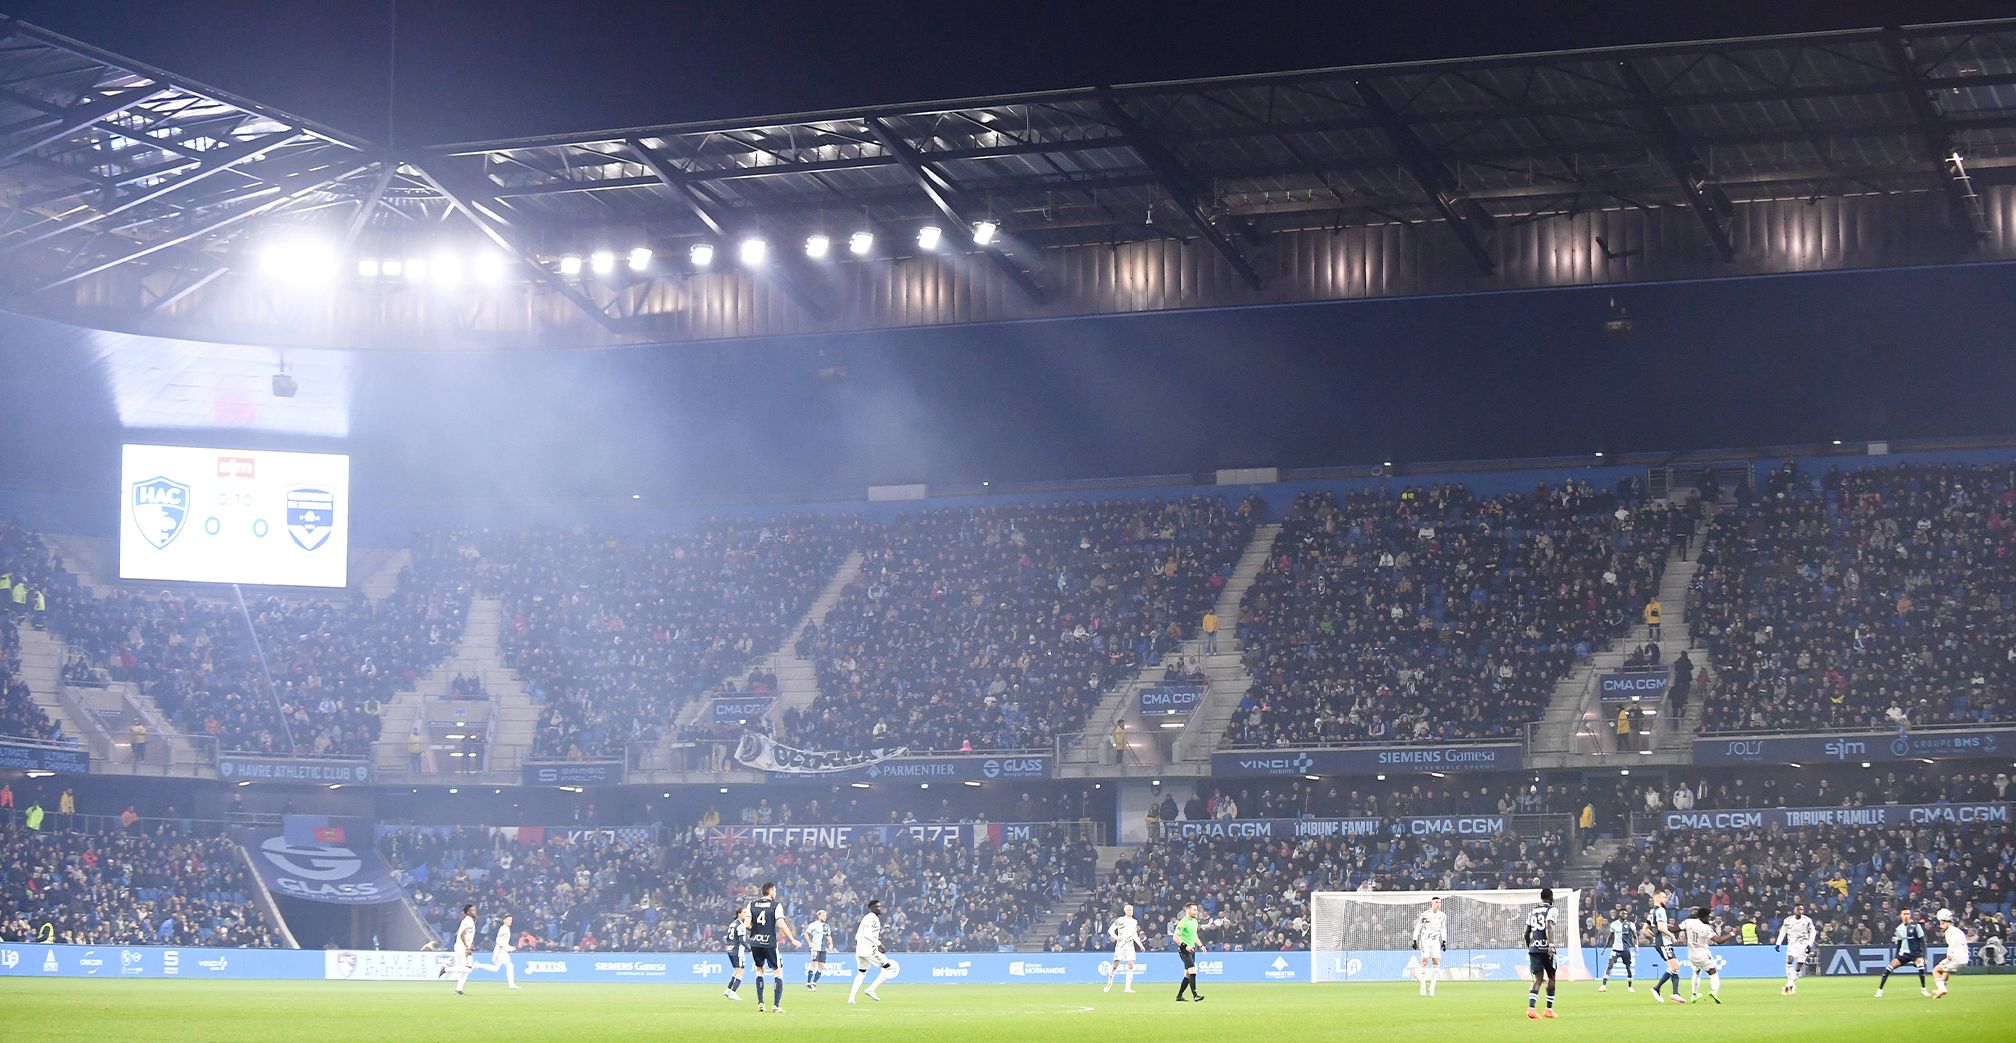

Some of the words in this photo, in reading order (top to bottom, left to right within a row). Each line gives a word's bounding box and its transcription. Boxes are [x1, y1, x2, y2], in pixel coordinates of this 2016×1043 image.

[139, 486, 182, 505] HAC
[204, 516, 220, 536] 0
[252, 518, 269, 538] 0
[1603, 680, 1634, 691] CMA
[1142, 694, 1171, 705] CMA
[716, 704, 742, 715] CMA
[1954, 737, 1980, 747] BMS
[1239, 759, 1289, 769] VINCI
[1379, 751, 1441, 764] SIEMENS
[1445, 749, 1495, 762] Gamesa
[238, 763, 272, 778] HAVRE
[274, 765, 321, 779] ATHLETIC
[323, 766, 350, 780] CLUB
[883, 763, 955, 777] PARMENTIER
[1003, 759, 1042, 772] GLASS
[1667, 814, 1712, 830] CMA
[1715, 812, 1762, 829] CGM
[1786, 810, 1833, 826] TRIBUNE
[1836, 809, 1885, 825] FAMILLE
[1910, 807, 1955, 823] CMA
[1959, 806, 2007, 822] CGM
[1227, 822, 1271, 837] CGM
[1294, 821, 1338, 837] TRIBUNE
[1411, 820, 1453, 835] CMA
[1458, 818, 1503, 834] CGM
[276, 877, 379, 897] GLASS
[756, 910, 766, 926] 4
[1530, 914, 1546, 932] 93
[595, 962, 634, 971] SIEMENS
[635, 961, 667, 971] Gamesa
[1024, 966, 1066, 975] NORMANDIE
[1199, 961, 1224, 969] GLASS
